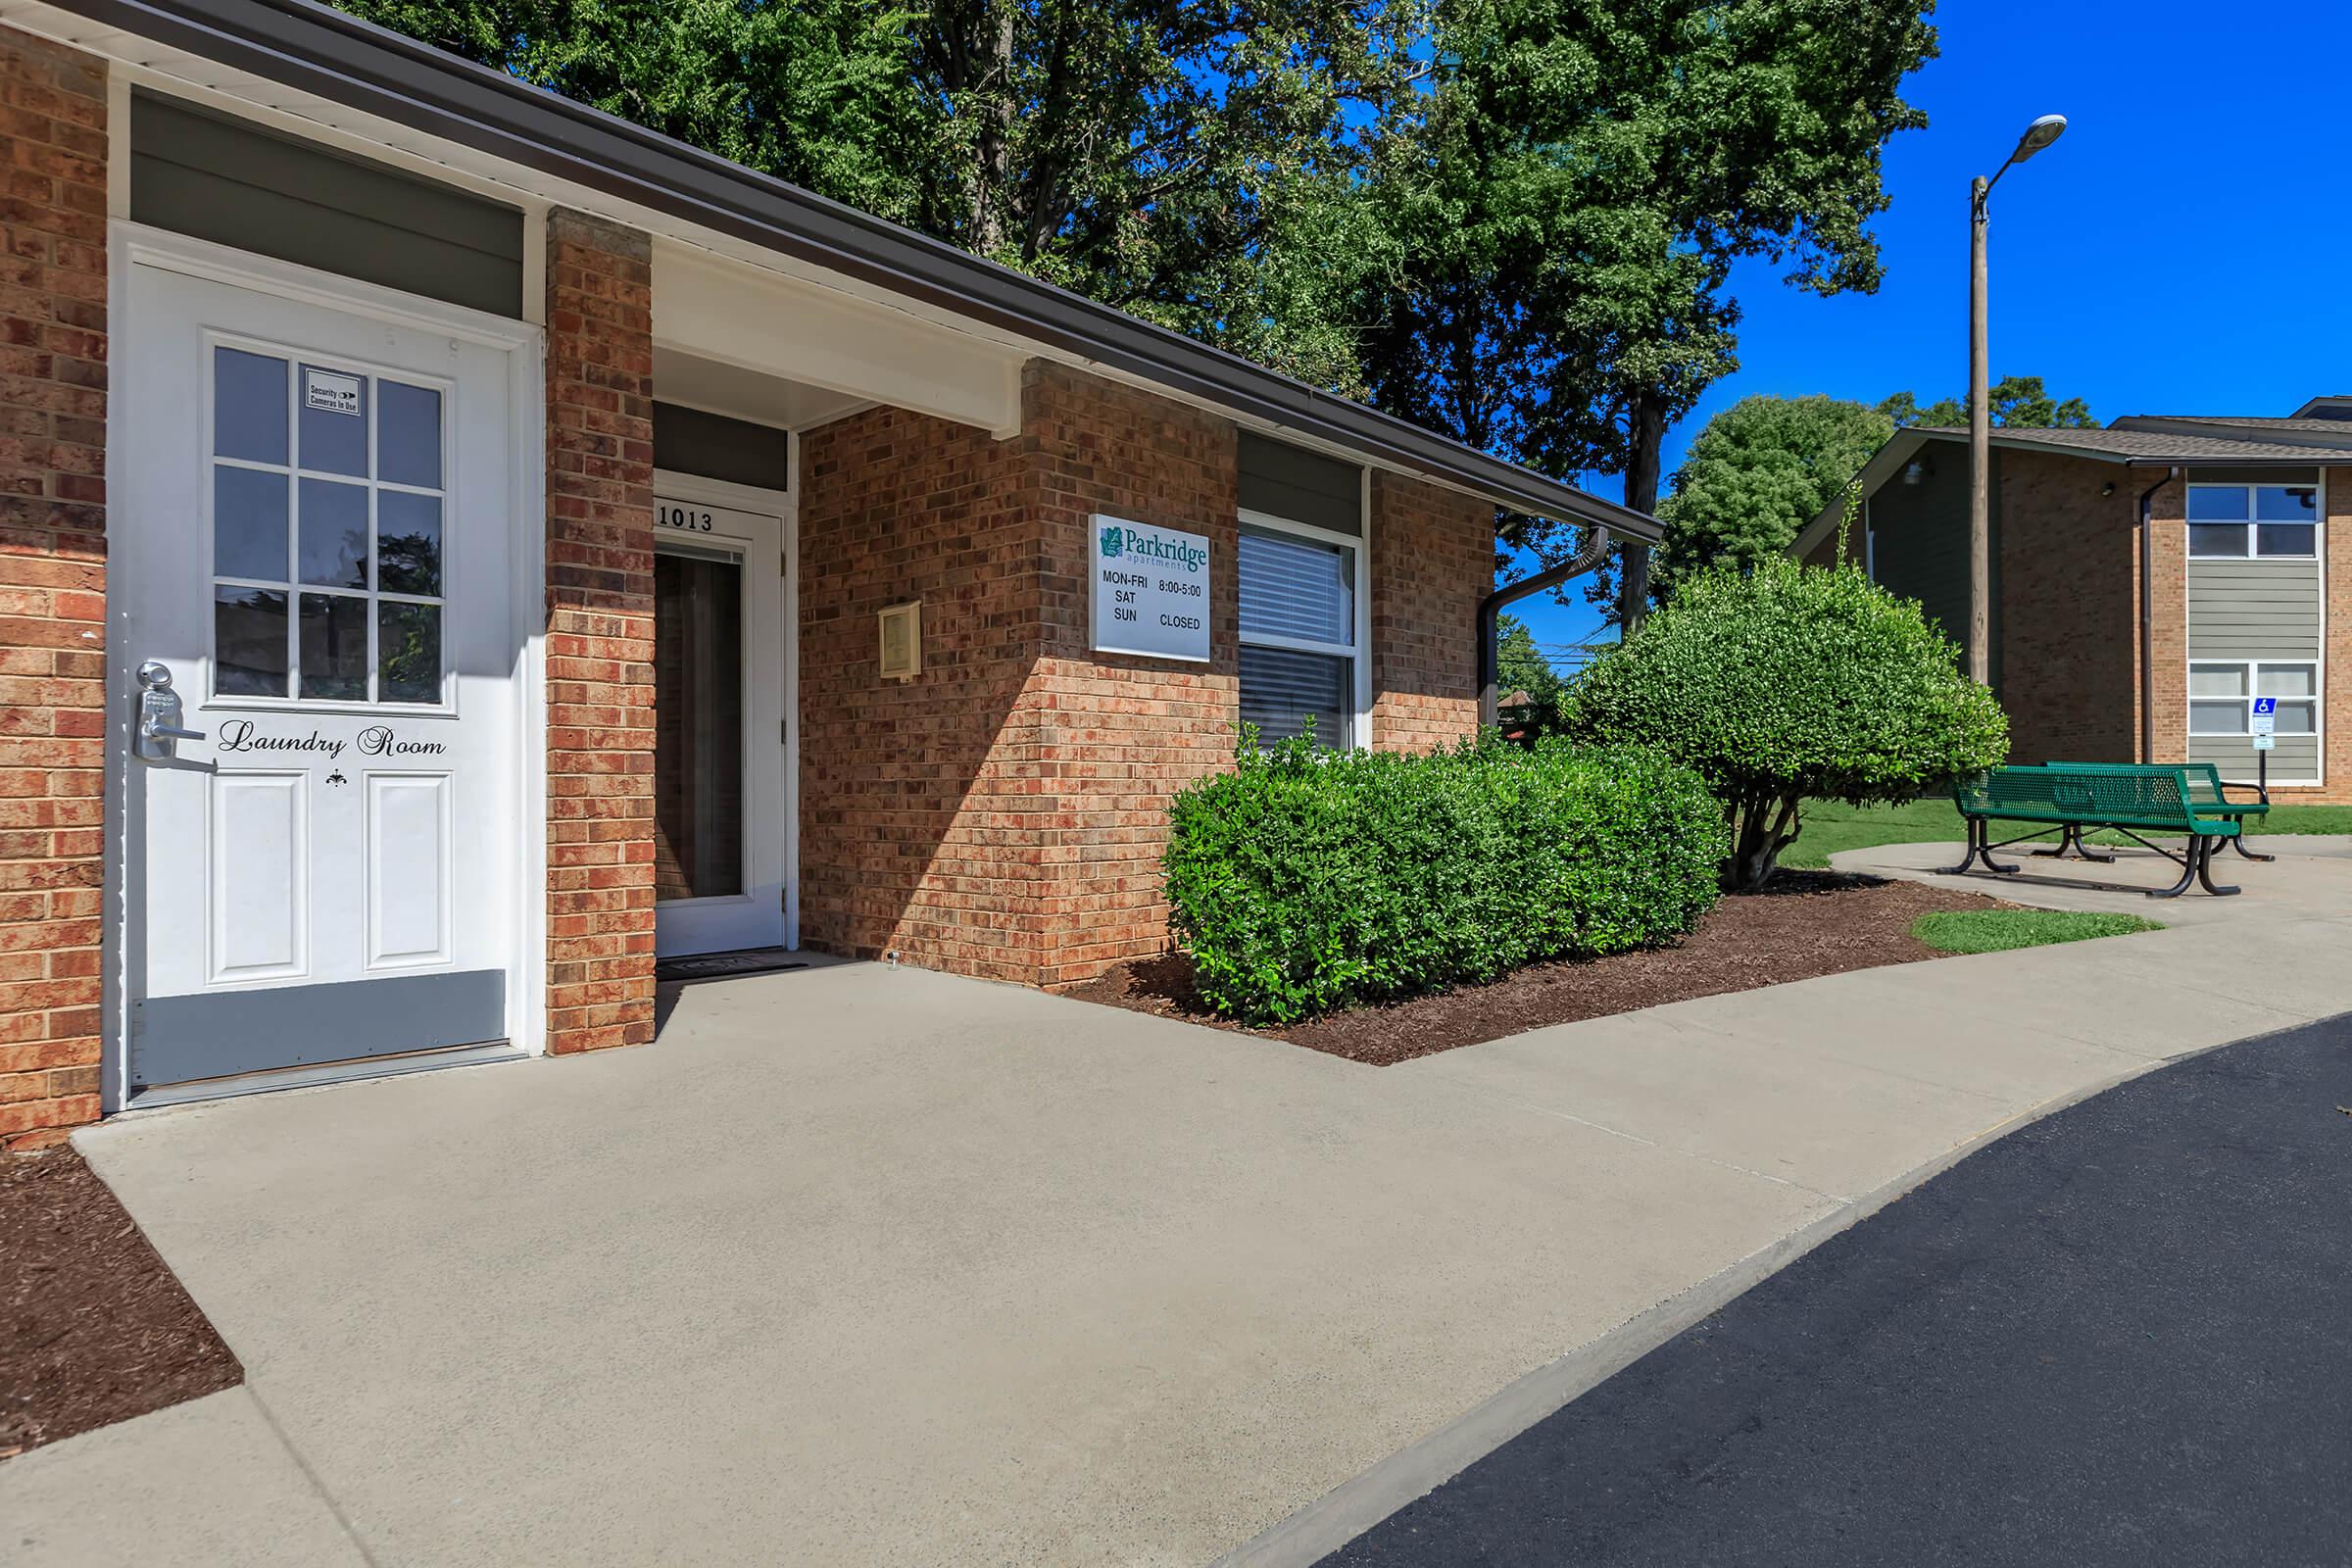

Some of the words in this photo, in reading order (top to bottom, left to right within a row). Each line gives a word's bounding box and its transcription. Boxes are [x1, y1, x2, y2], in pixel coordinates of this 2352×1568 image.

[311, 385, 337, 399] Security
[311, 395, 337, 408] Cameras
[345, 402, 357, 412] Use
[660, 506, 711, 531] 1013
[1125, 528, 1206, 572] Parkridge
[1127, 555, 1186, 571] apartments
[1102, 569, 1148, 589] MON-FRI
[1158, 580, 1201, 597] 8:00-5:00
[1115, 590, 1136, 604] SAT
[1114, 608, 1137, 621] SUN
[1159, 613, 1200, 630] CLOSED
[219, 719, 347, 760] Laundry
[357, 725, 447, 757] Room
